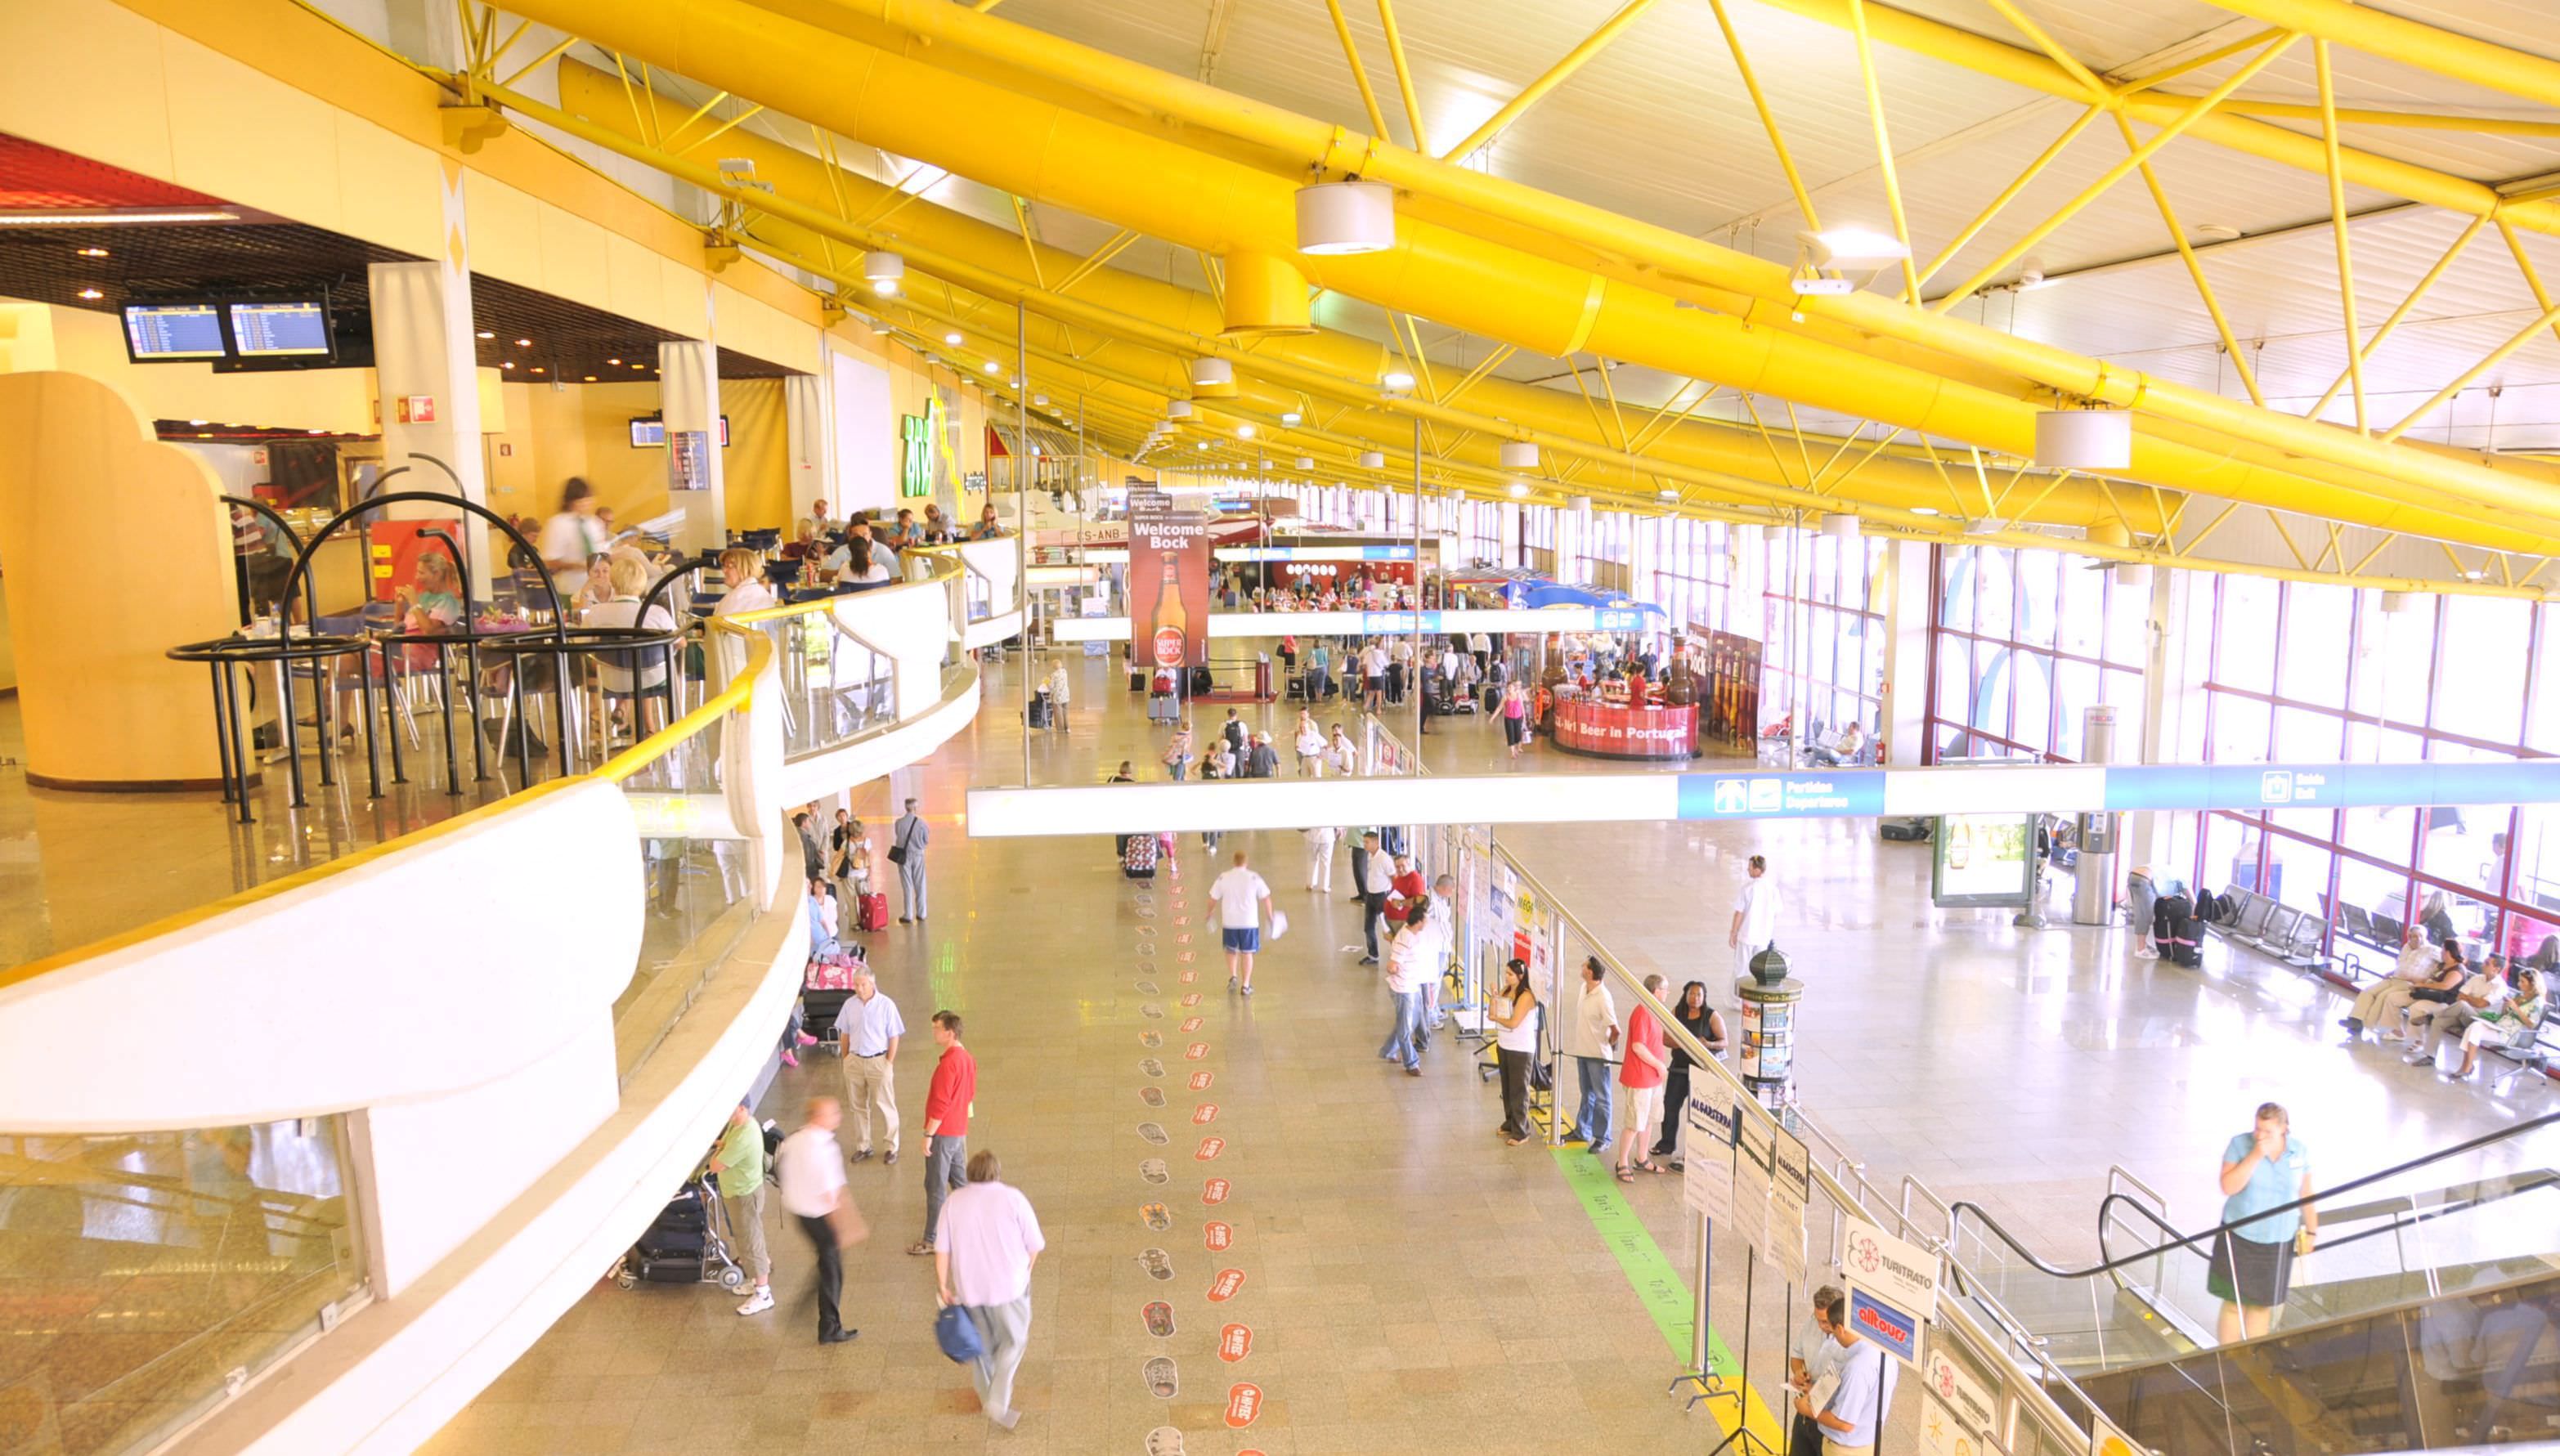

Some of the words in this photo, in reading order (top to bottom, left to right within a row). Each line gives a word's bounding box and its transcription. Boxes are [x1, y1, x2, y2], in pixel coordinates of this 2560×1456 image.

[1130, 499, 1170, 507] Welcome
[1134, 522, 1204, 535] Welcome
[1150, 535, 1189, 549] Bock
[1156, 638, 1182, 647] SUPER
[1157, 646, 1181, 655] BOCK
[1580, 723, 1607, 737] Beer
[1610, 726, 1622, 738] in
[1626, 725, 1688, 741] Portugal
[1881, 1256, 1933, 1289] TURITRATO
[1858, 1307, 1908, 1342] alltours
